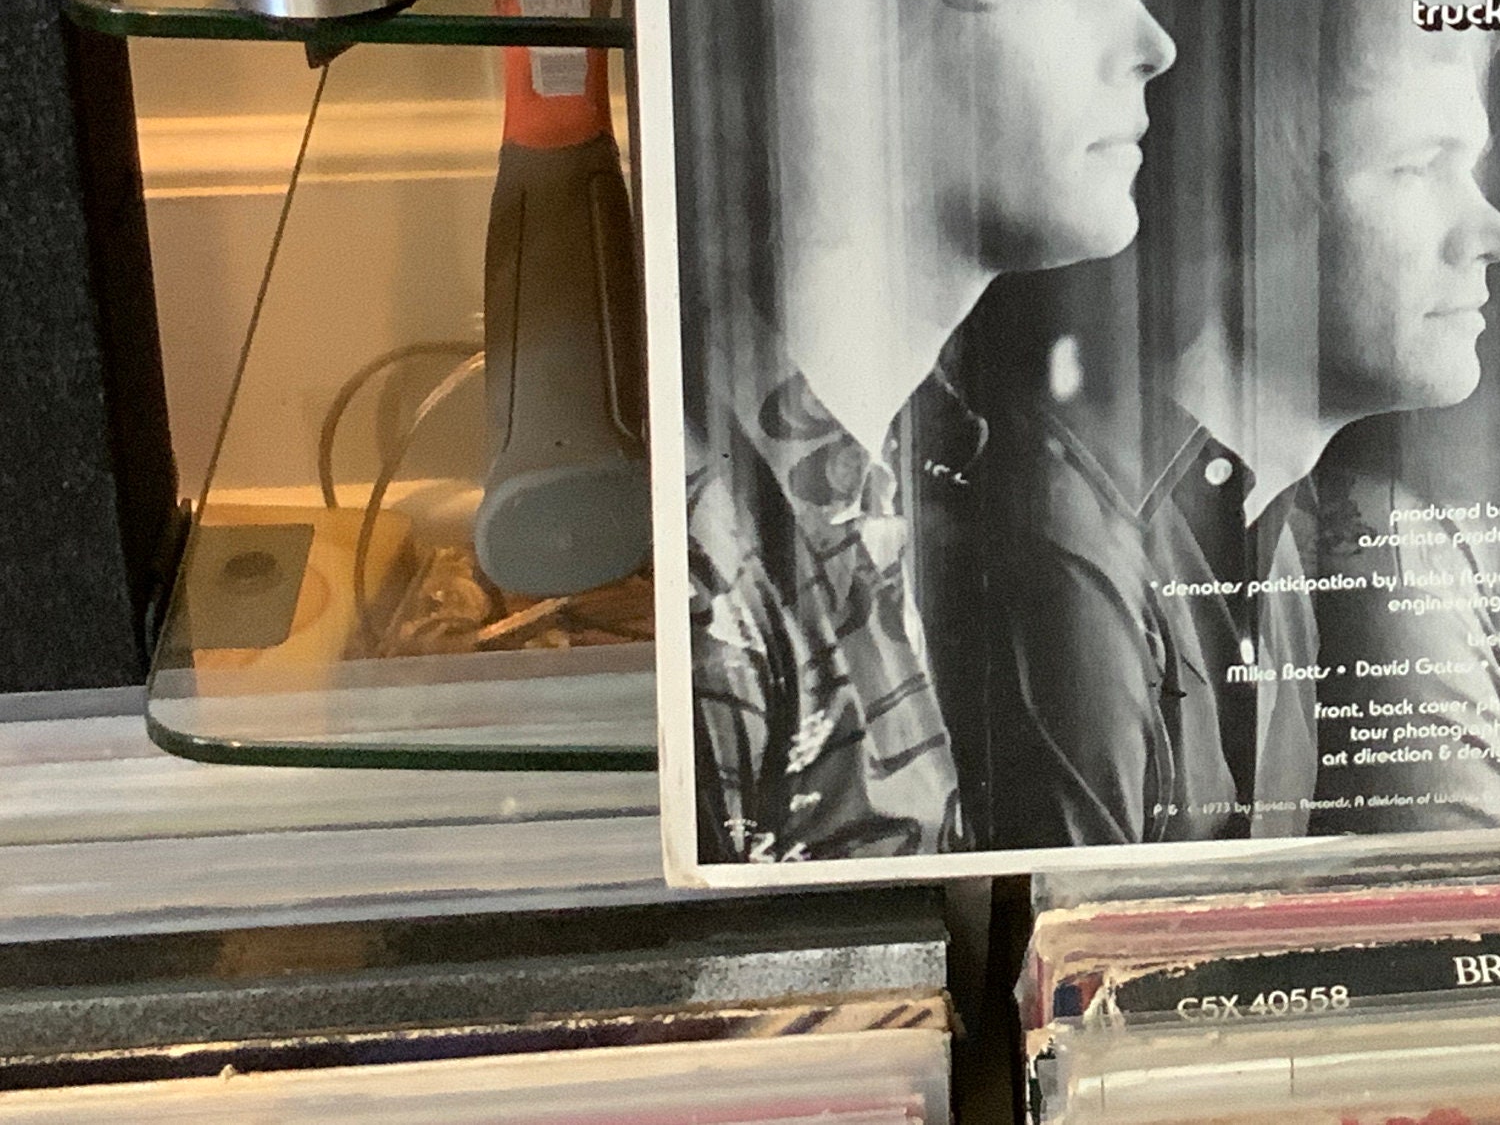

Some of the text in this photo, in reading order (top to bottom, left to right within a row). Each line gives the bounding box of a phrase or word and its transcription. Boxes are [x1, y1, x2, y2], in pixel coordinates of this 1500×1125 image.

[1390, 503, 1480, 525] produced
[1358, 529, 1447, 548] associate
[1248, 574, 1367, 598] participation
[1372, 570, 1397, 592] by
[1226, 663, 1277, 683] Mike
[1282, 663, 1332, 681] Botts
[1355, 659, 1410, 678] David
[1369, 699, 1413, 718] back
[1418, 700, 1469, 717] cover
[1350, 725, 1389, 742] tour
[1322, 749, 1348, 766] art
[1353, 745, 1434, 765] direction
[1438, 745, 1452, 761] &
[1416, 792, 1431, 805] of
[1176, 985, 1350, 1022] C5X 40558
